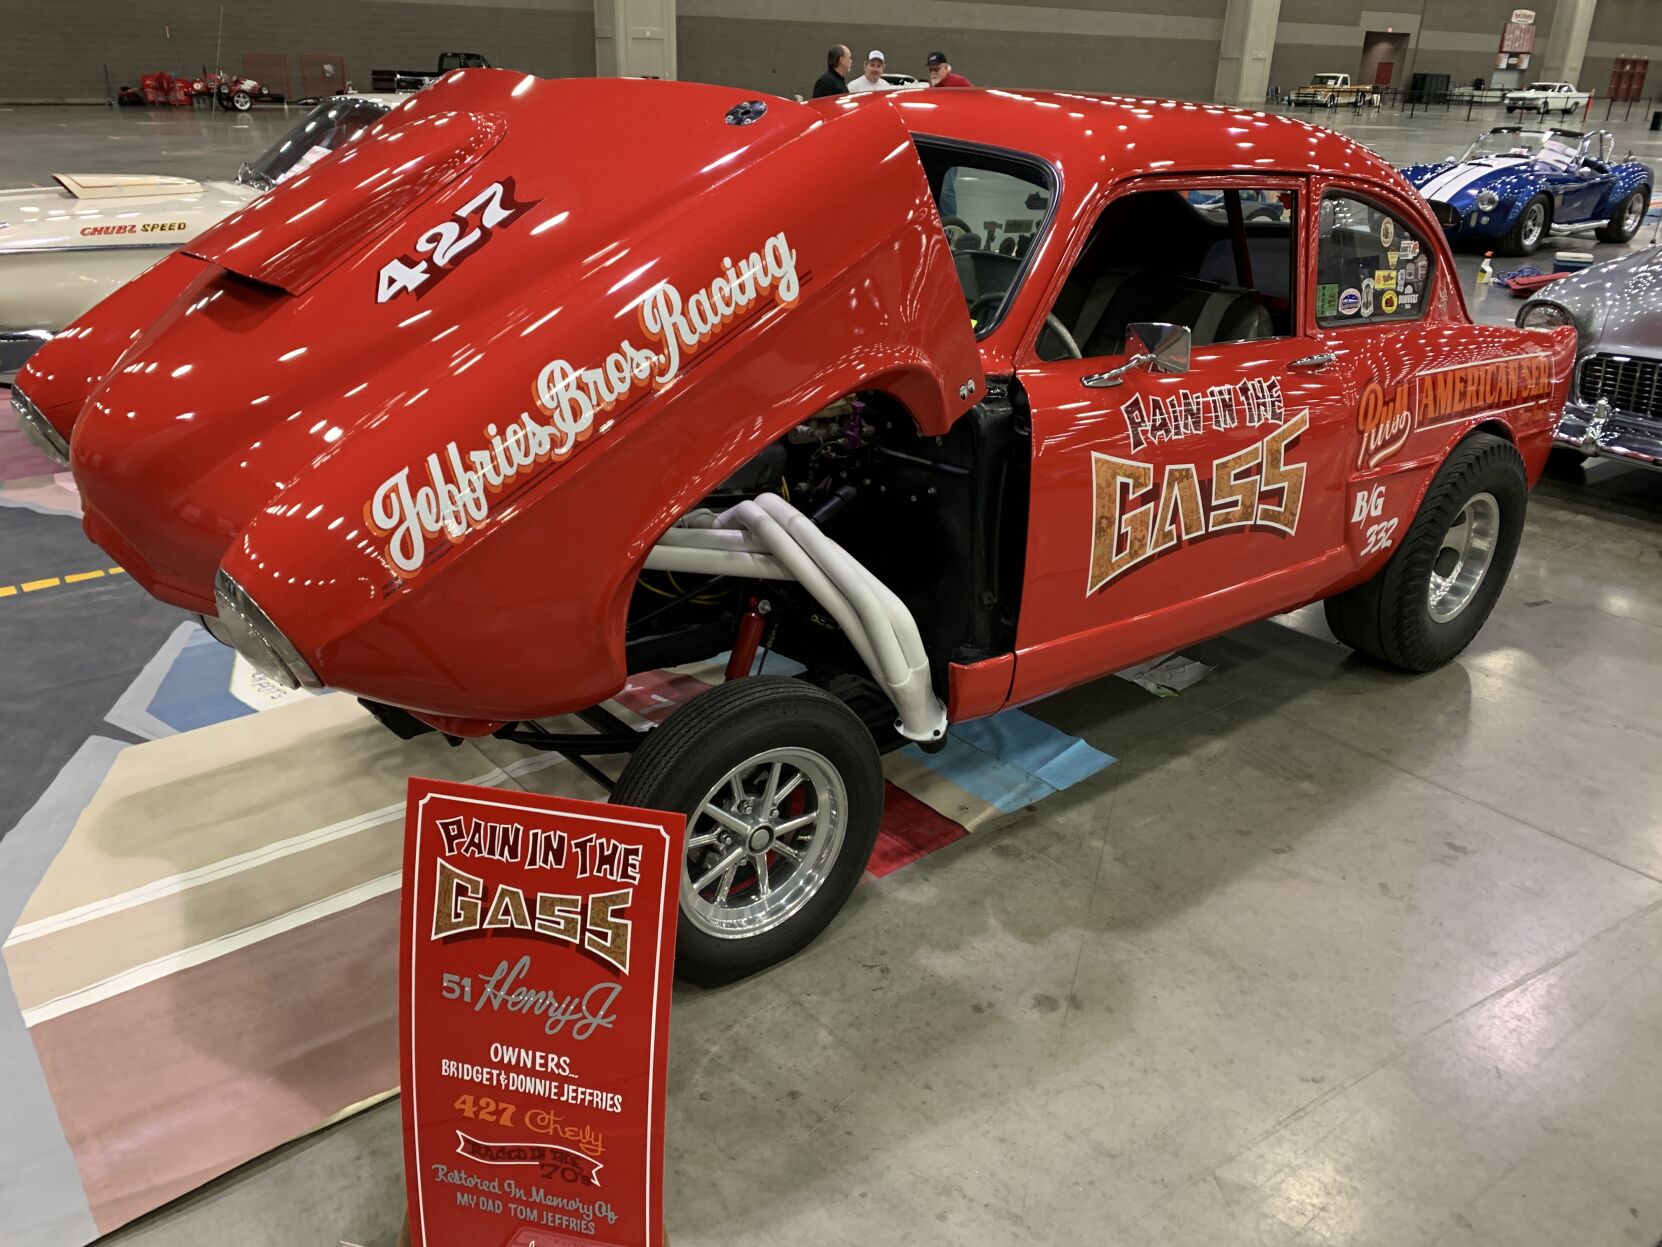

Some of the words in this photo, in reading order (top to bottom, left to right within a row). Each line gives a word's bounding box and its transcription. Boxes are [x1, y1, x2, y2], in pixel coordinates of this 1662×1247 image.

[140, 222, 187, 233] SPEED
[375, 180, 517, 304] 427
[366, 412, 556, 577] Jeffries
[639, 231, 801, 385] Racing
[1120, 391, 1203, 455] PAIN
[1206, 384, 1237, 432] IN
[1236, 375, 1286, 429] THE
[1419, 360, 1519, 421] AMERICAN
[1085, 407, 1309, 599] GASS
[1351, 483, 1386, 529] B/G
[1360, 517, 1399, 556] 332
[435, 815, 523, 863] PAIN
[524, 828, 567, 870] IN
[571, 833, 643, 885] THE
[430, 857, 633, 976] GASS
[442, 973, 472, 1003] 51
[474, 955, 583, 1035] Henry
[454, 1094, 516, 1128] 427
[525, 1109, 605, 1156] Chevy
[560, 1084, 623, 1113] JEFFRIES
[432, 1164, 502, 1195] Restored
[504, 1179, 527, 1201] In
[529, 1186, 593, 1220] Memory
[594, 1200, 619, 1224] Of
[456, 1192, 476, 1208] MY
[479, 1196, 503, 1214] DAD
[508, 1203, 538, 1222] TOM
[540, 1213, 596, 1236] JEFFRIES
